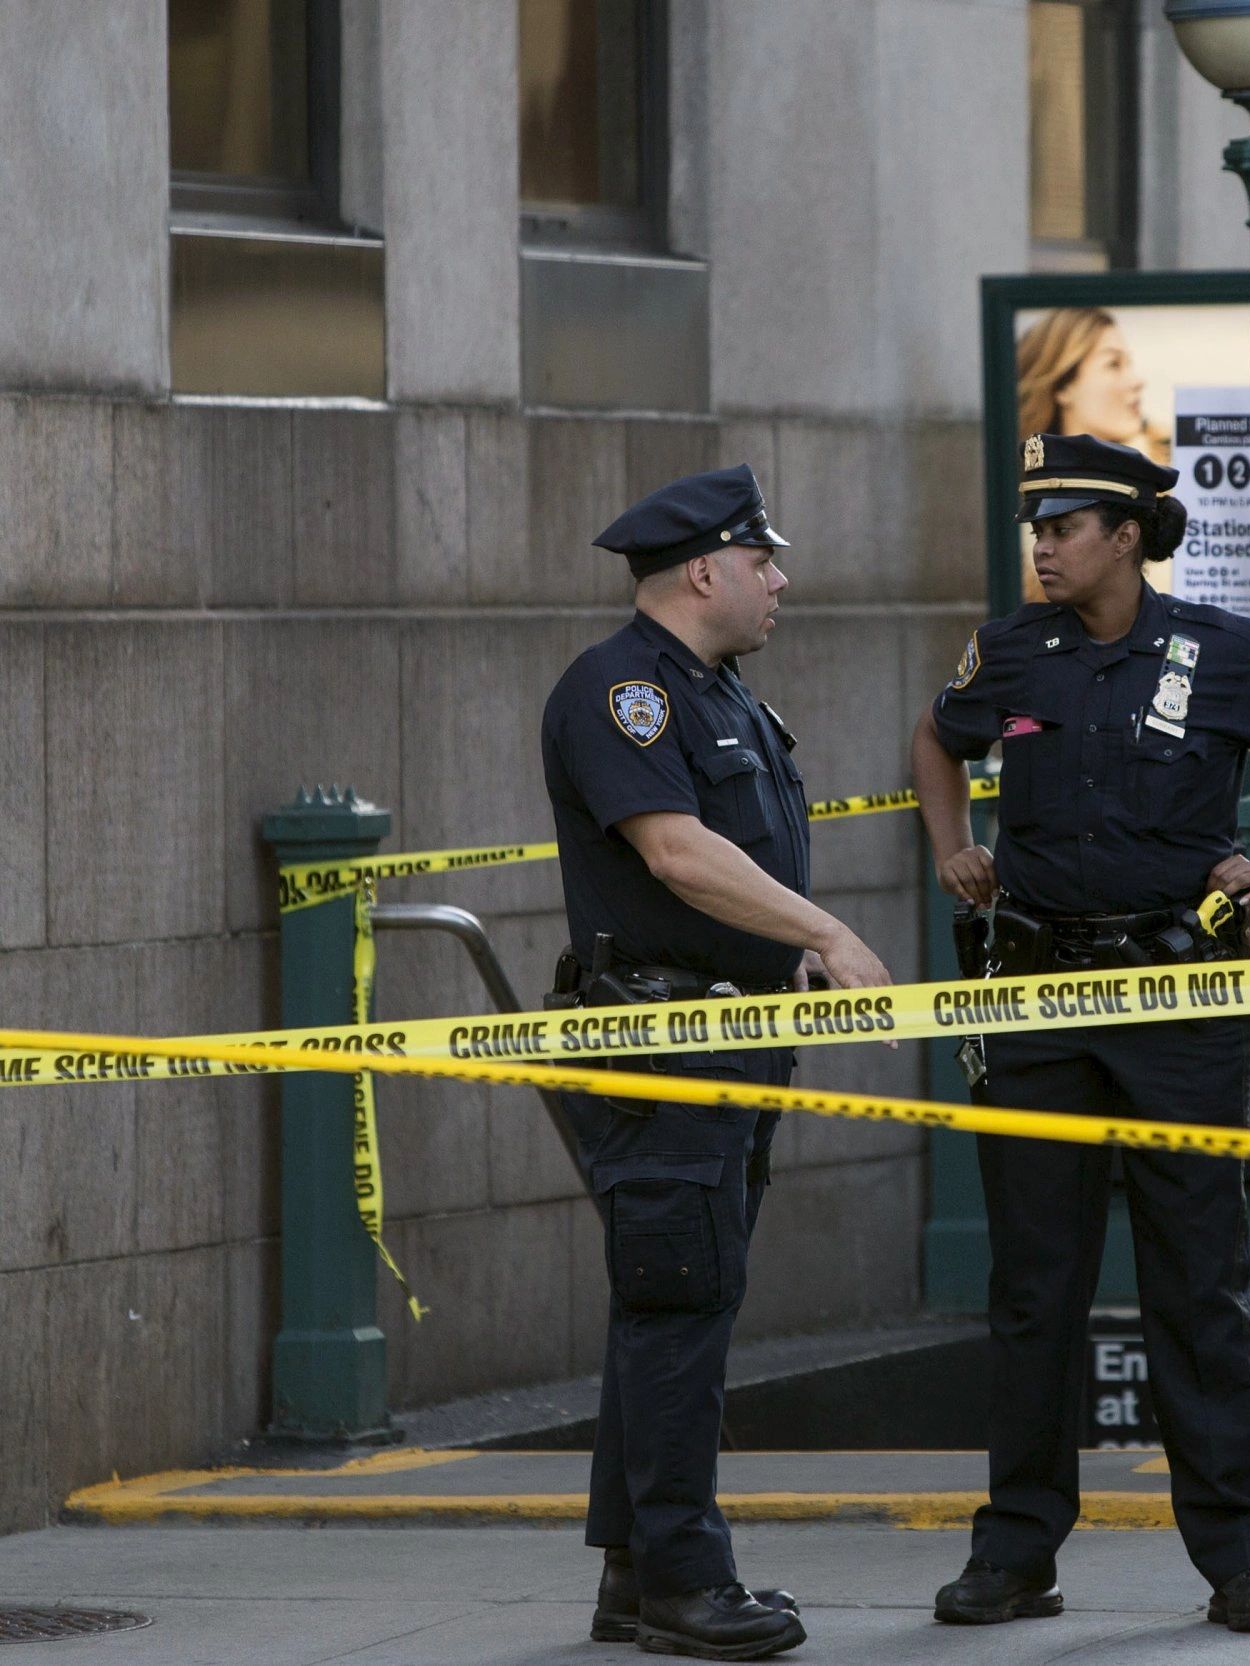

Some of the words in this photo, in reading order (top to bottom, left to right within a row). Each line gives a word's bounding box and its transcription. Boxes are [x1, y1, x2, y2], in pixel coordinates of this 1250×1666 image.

[1195, 417, 1247, 433] Planned
[615, 691, 664, 706] DEPARTMENT
[625, 685, 654, 694] POLICE
[616, 709, 628, 724] CITY
[626, 724, 637, 735] OF
[645, 725, 658, 739] NEW
[933, 985, 1029, 1027] CRIME
[1037, 978, 1131, 1019] SCENE
[1138, 974, 1178, 1010] DO
[1187, 970, 1246, 1008] NOT
[449, 1020, 550, 1060] CRIME
[560, 1013, 659, 1053] SCENE
[668, 1009, 709, 1044] DO
[720, 1005, 781, 1041] NOT
[793, 996, 895, 1037] CROSS
[1096, 1390, 1140, 1426] at
